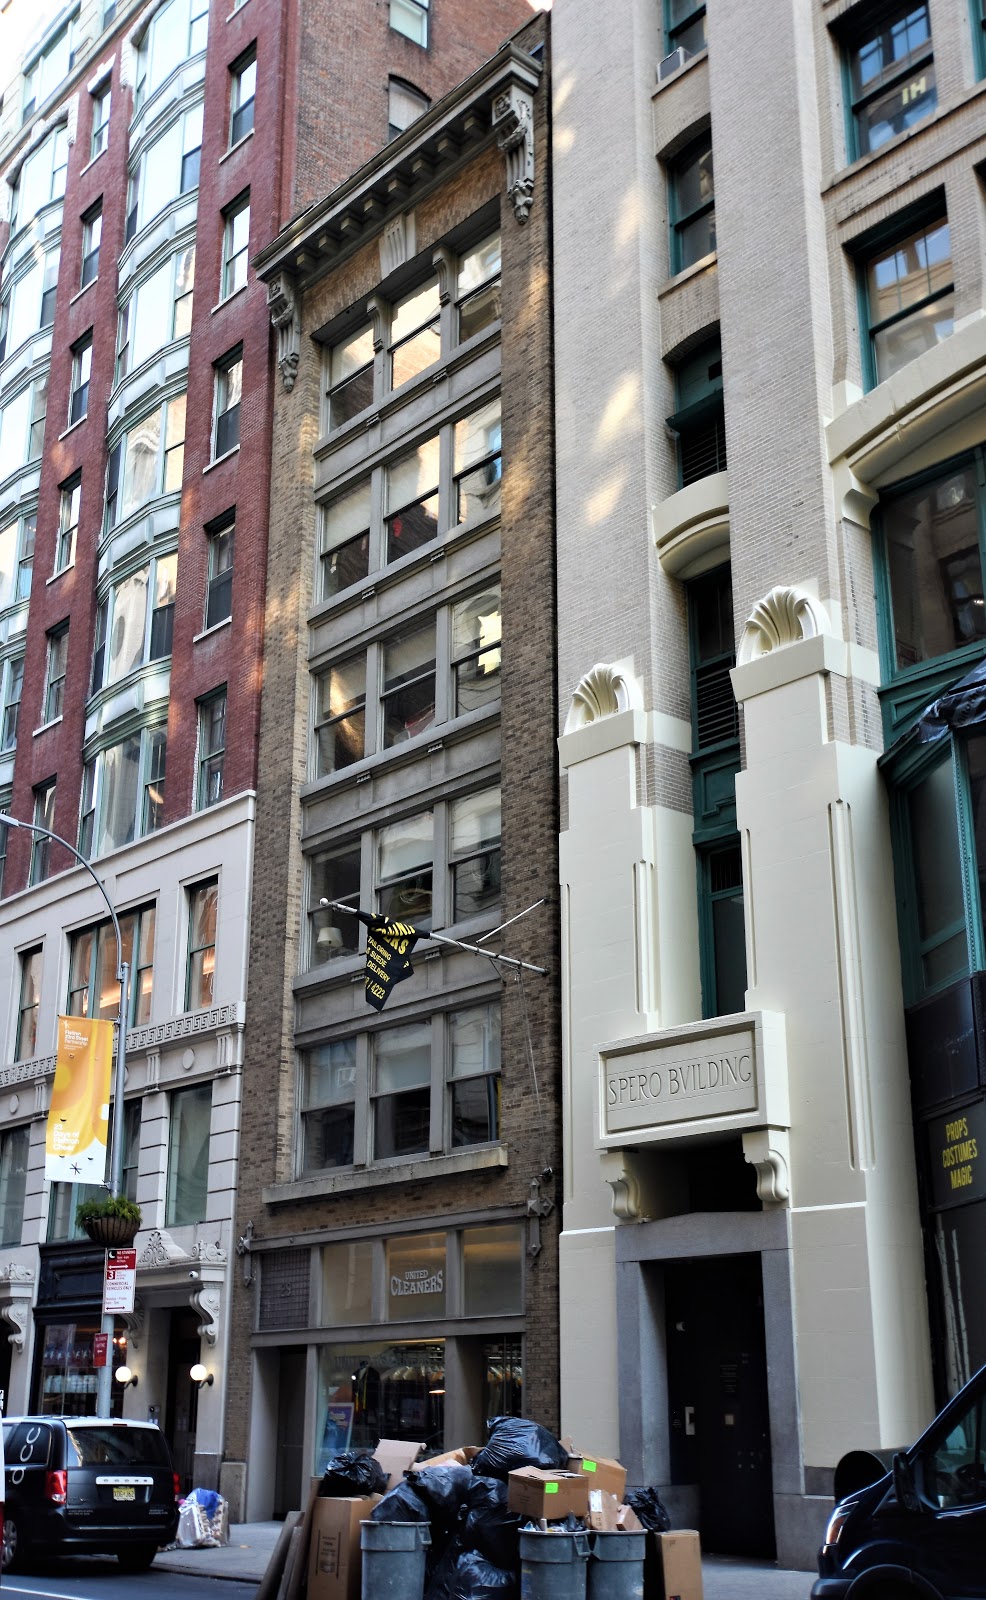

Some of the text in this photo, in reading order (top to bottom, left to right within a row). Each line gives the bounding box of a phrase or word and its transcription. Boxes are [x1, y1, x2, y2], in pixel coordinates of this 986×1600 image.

[367, 936, 391, 960] TAILORING
[370, 950, 387, 968] SUEDE
[366, 960, 390, 983] DELIVERY
[371, 983, 386, 1000] 4223
[608, 1055, 751, 1105] SPERO BVILDING
[946, 1117, 968, 1142] PROPS
[942, 1138, 978, 1168] COSTUMES
[950, 1165, 973, 1189] MAGIC
[108, 1271, 114, 1279] 3
[390, 1270, 443, 1296] CLEANERS
[405, 1269, 428, 1280] UNITED
